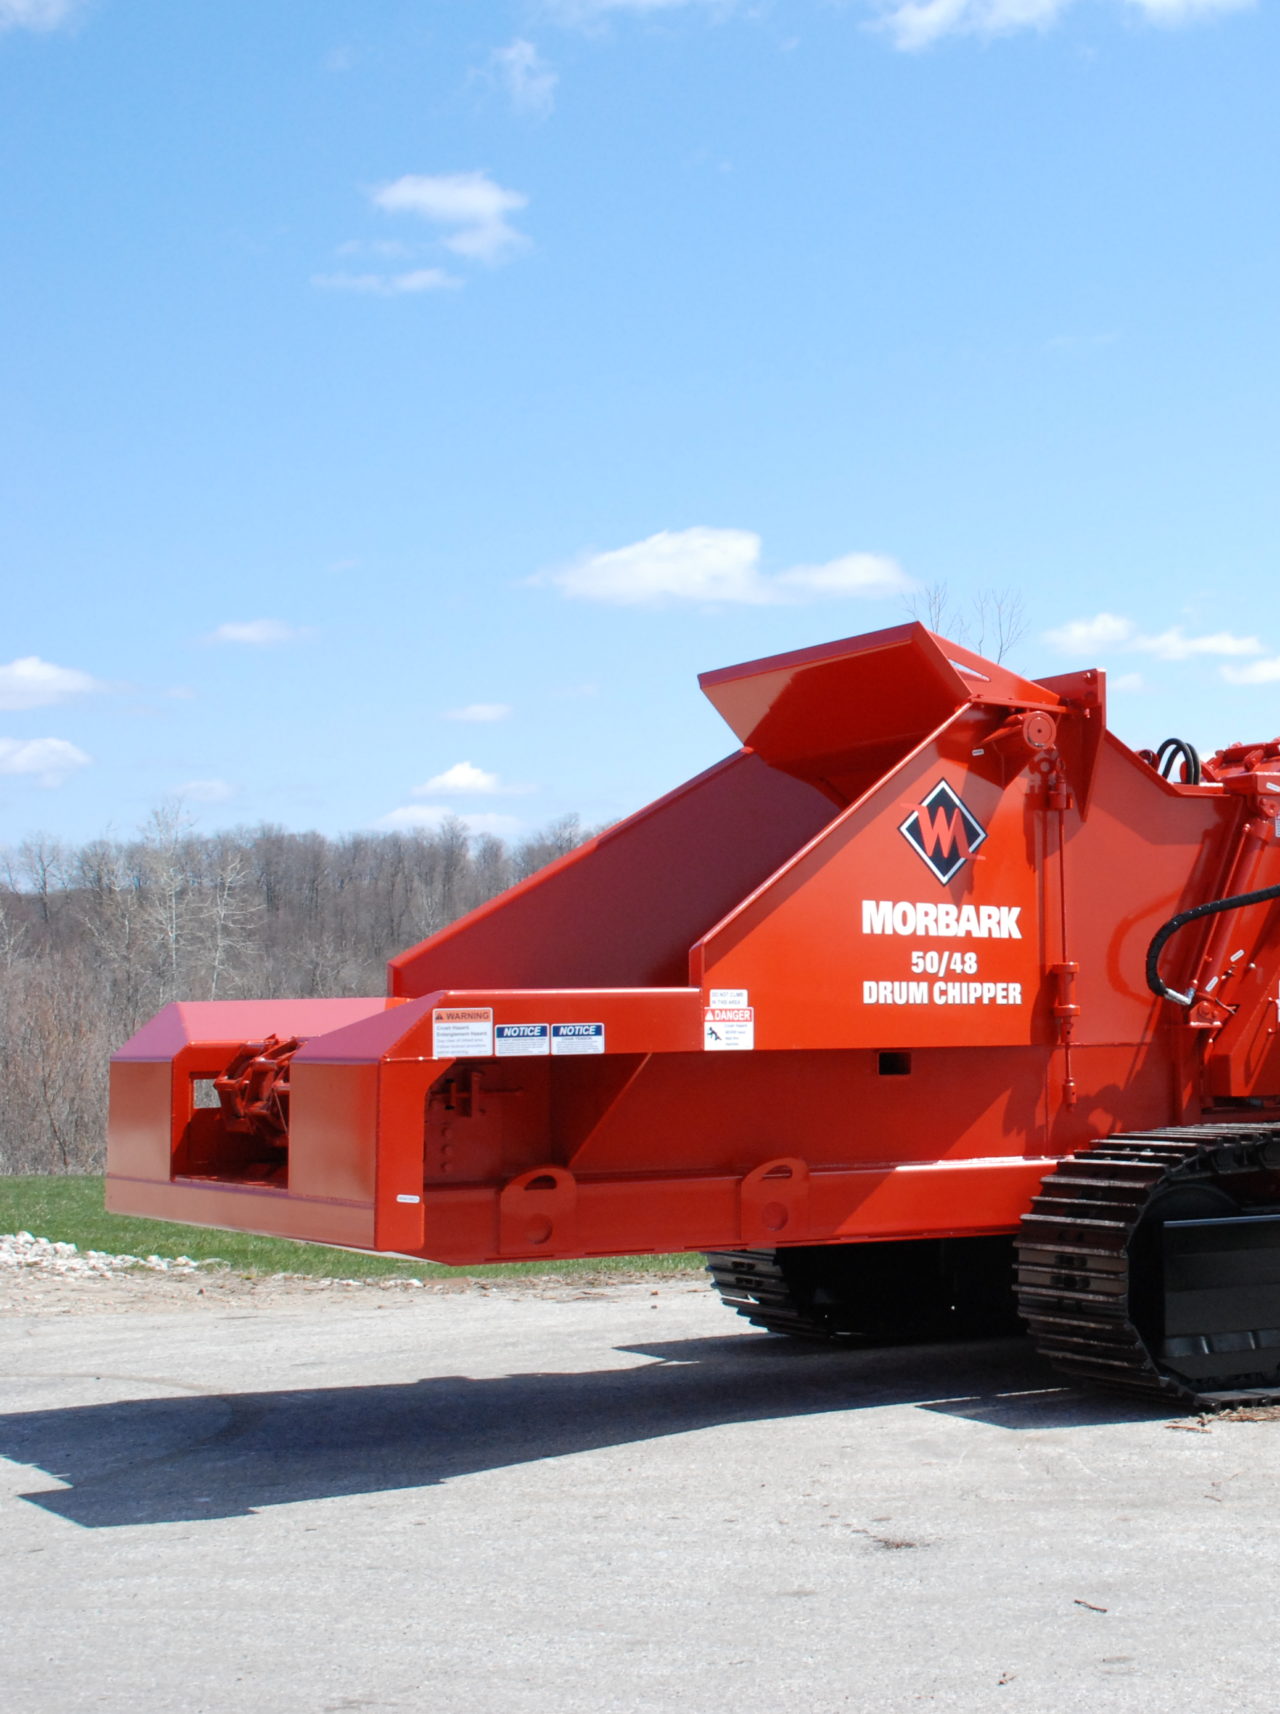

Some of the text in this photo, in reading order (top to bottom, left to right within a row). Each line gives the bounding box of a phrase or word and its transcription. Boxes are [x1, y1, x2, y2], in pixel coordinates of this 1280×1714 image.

[862, 899, 1022, 939] MORBARK
[911, 951, 977, 977] 50/48
[862, 980, 1022, 1004] DRUM CHIPPER
[446, 1012, 489, 1020] WARNING
[714, 1009, 751, 1021] DANGER
[503, 1026, 542, 1037] NOTICE
[559, 1025, 597, 1036] NOTICE
